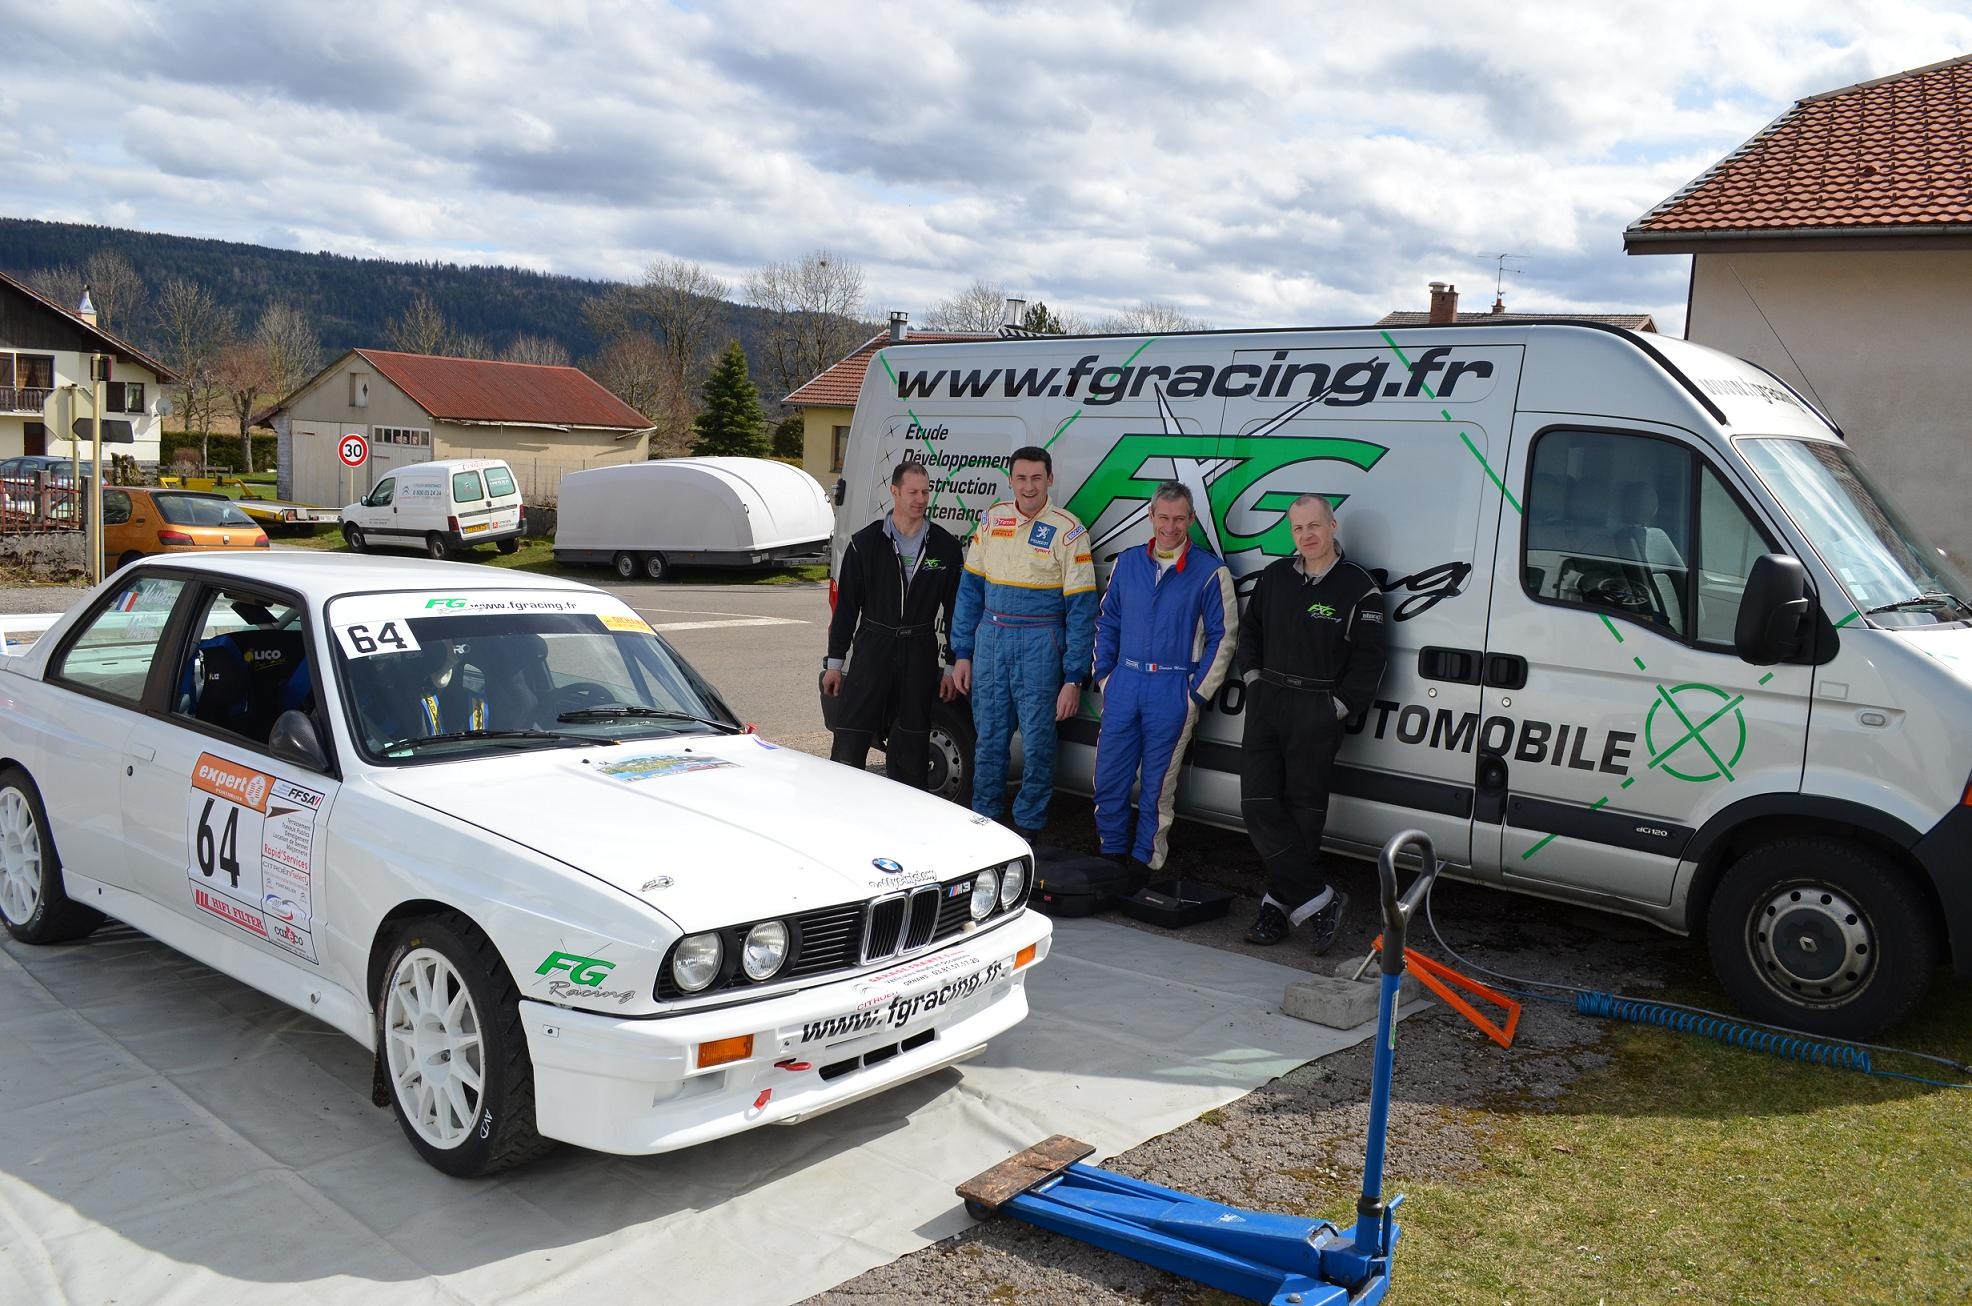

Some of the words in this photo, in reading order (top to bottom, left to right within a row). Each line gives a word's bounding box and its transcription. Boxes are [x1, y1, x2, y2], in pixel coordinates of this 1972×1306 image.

[897, 347, 1494, 406] www.fgracing.fr
[905, 423, 949, 441] Etude
[344, 444, 362, 458] 30
[902, 448, 1011, 472] Développemen
[928, 477, 998, 496] struction
[1063, 433, 1390, 556] FG
[925, 504, 983, 521] ntenanc
[424, 598, 468, 608] FG
[470, 601, 577, 610] www.fgracing.fr
[346, 622, 408, 653] 64
[254, 650, 281, 660] LICO
[1345, 699, 1637, 777] TOMOBILE
[199, 765, 248, 793] expert
[287, 788, 317, 806] FFSA
[196, 797, 240, 888] 64
[264, 843, 308, 870] Rapid'Services
[211, 897, 231, 915] HIFI
[232, 906, 264, 930] FILTER
[535, 951, 617, 987] FG
[549, 980, 637, 1004] Racing
[800, 959, 1003, 1043] www.fgracing.fr
